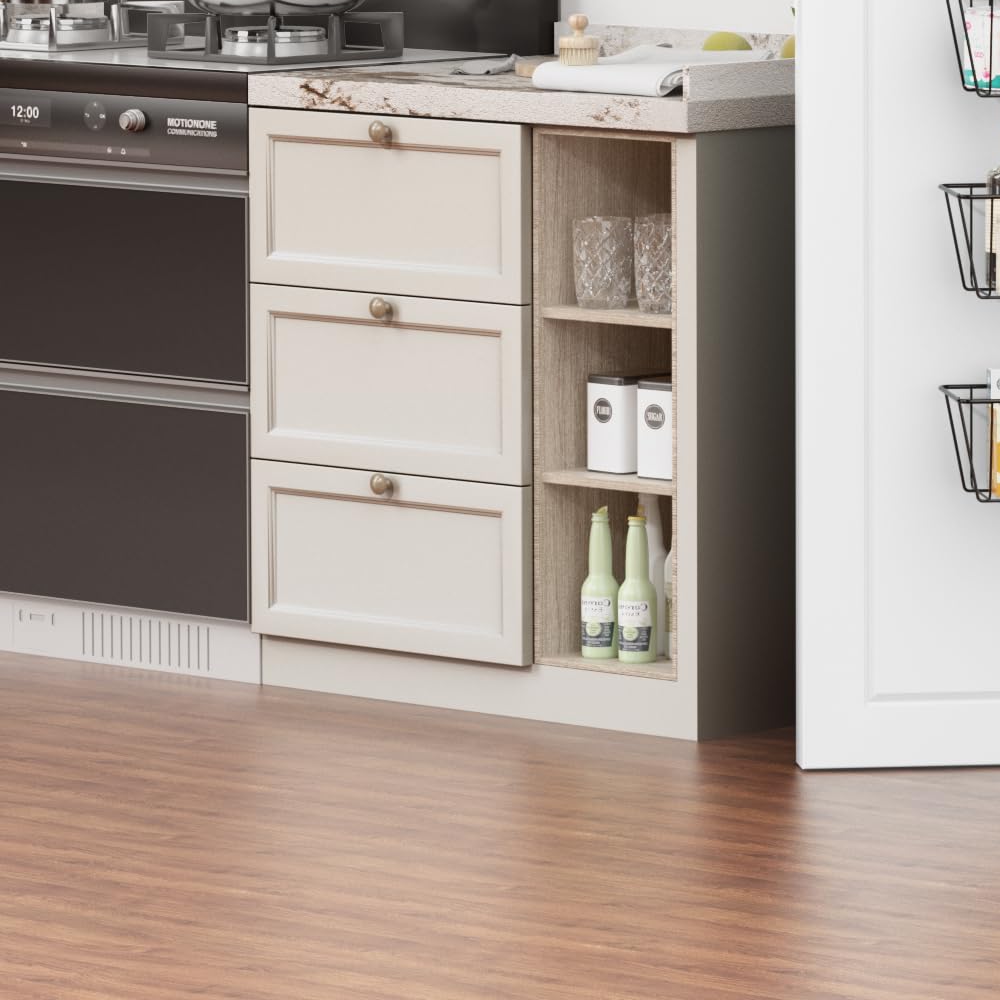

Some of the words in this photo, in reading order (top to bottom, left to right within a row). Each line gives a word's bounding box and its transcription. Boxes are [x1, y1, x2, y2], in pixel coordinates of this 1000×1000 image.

[11, 105, 39, 119] 12:00
[167, 118, 217, 129] MOTIONONE
[167, 128, 218, 137] COMMUNICATIONS
